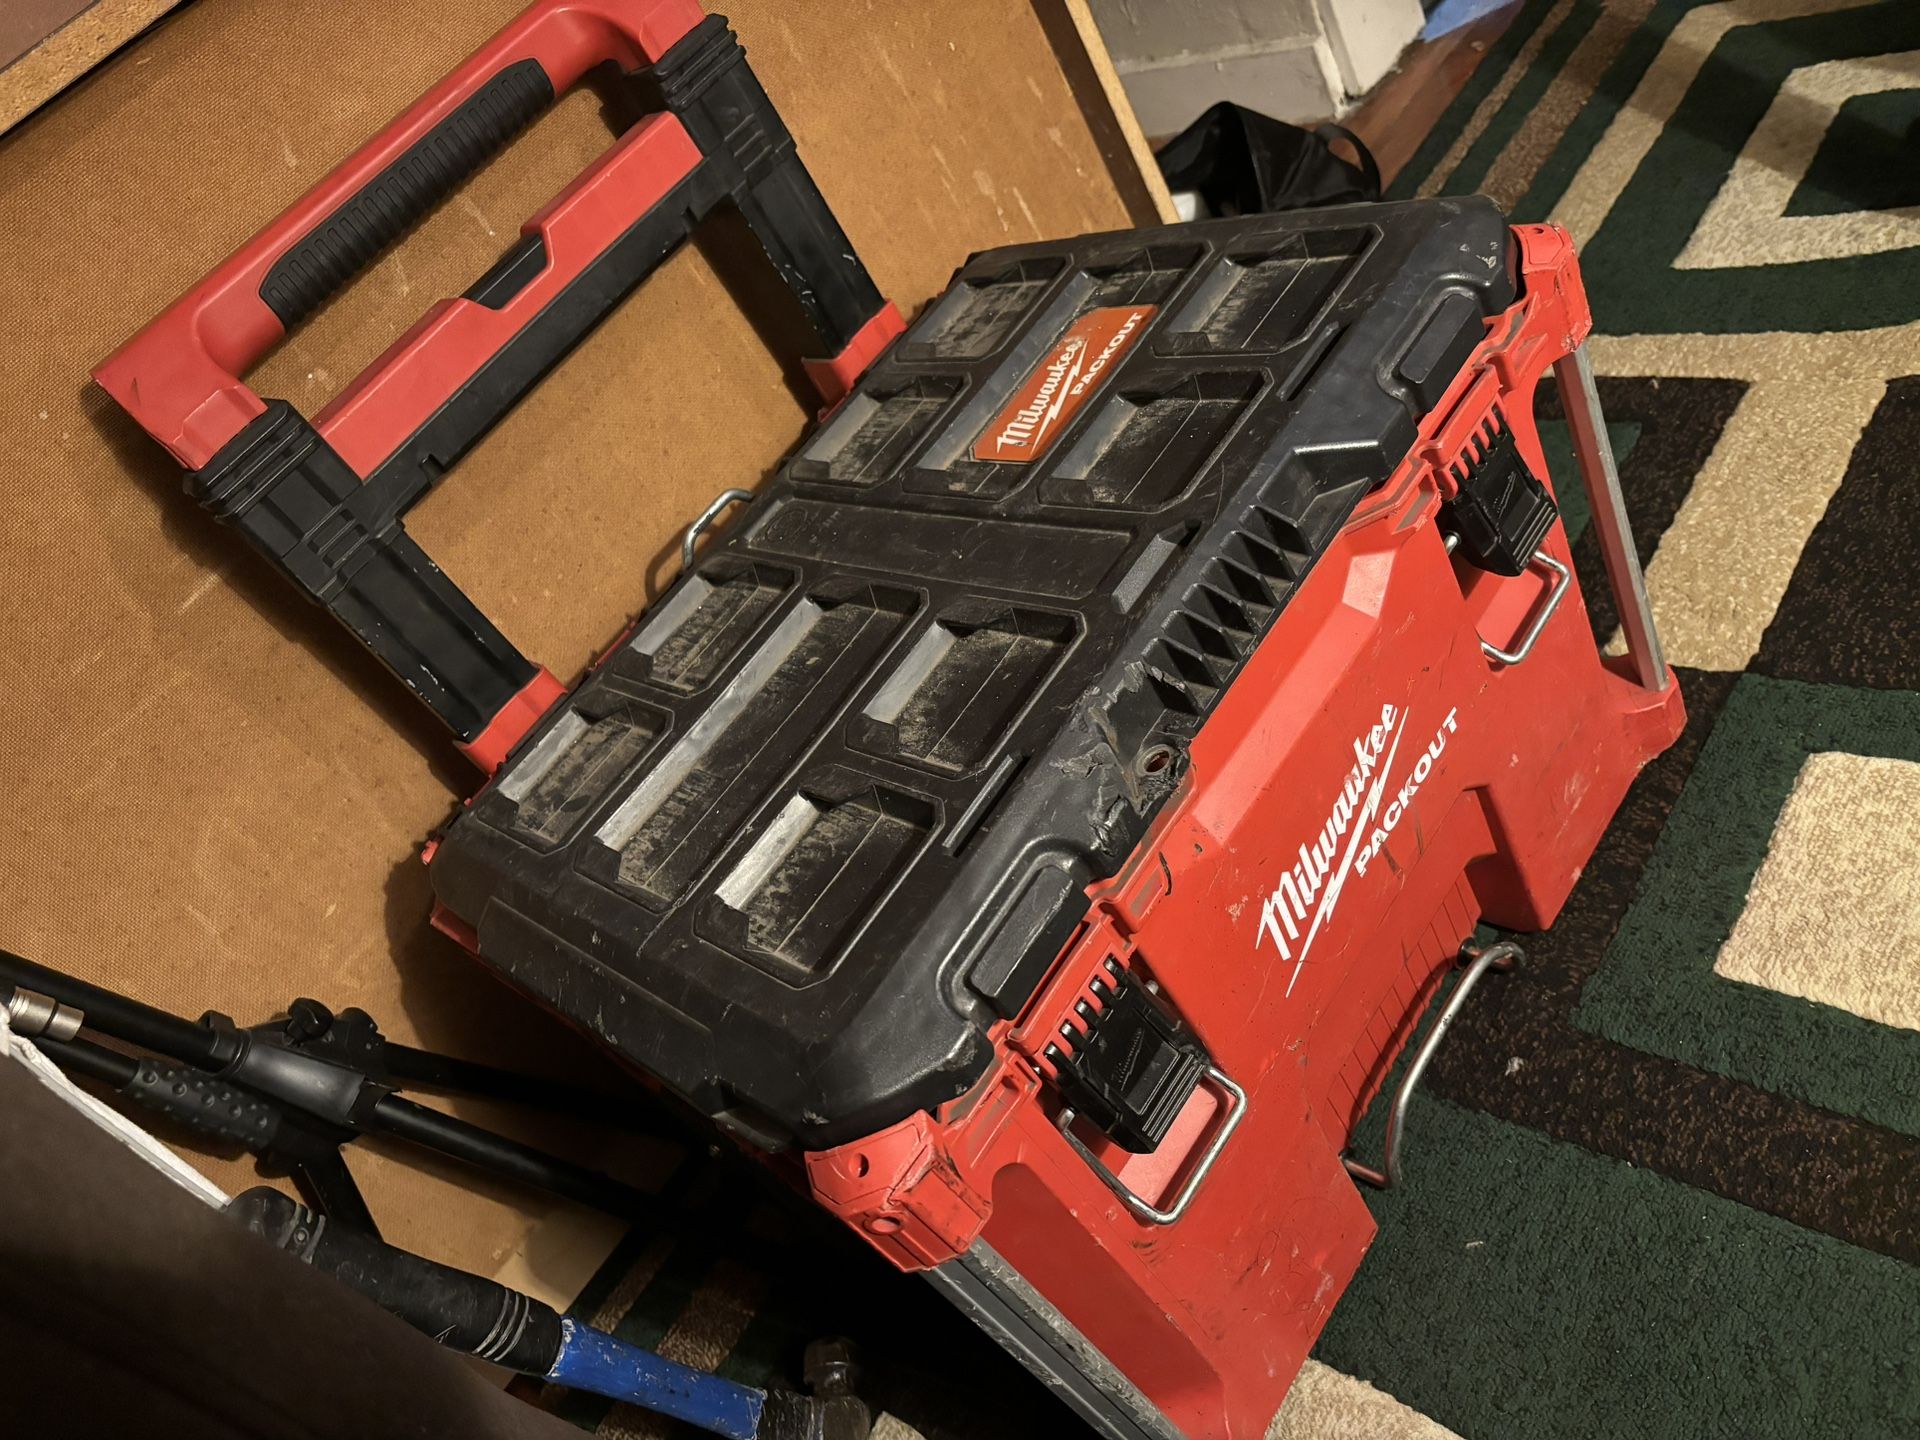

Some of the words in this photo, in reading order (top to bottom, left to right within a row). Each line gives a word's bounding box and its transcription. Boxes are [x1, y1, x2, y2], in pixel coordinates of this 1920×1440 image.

[996, 338, 1085, 454] Milwaukee
[1069, 312, 1143, 396] PACKOUT
[1255, 703, 1398, 960] Milwaukee
[1354, 706, 1458, 878] PACKOUT
